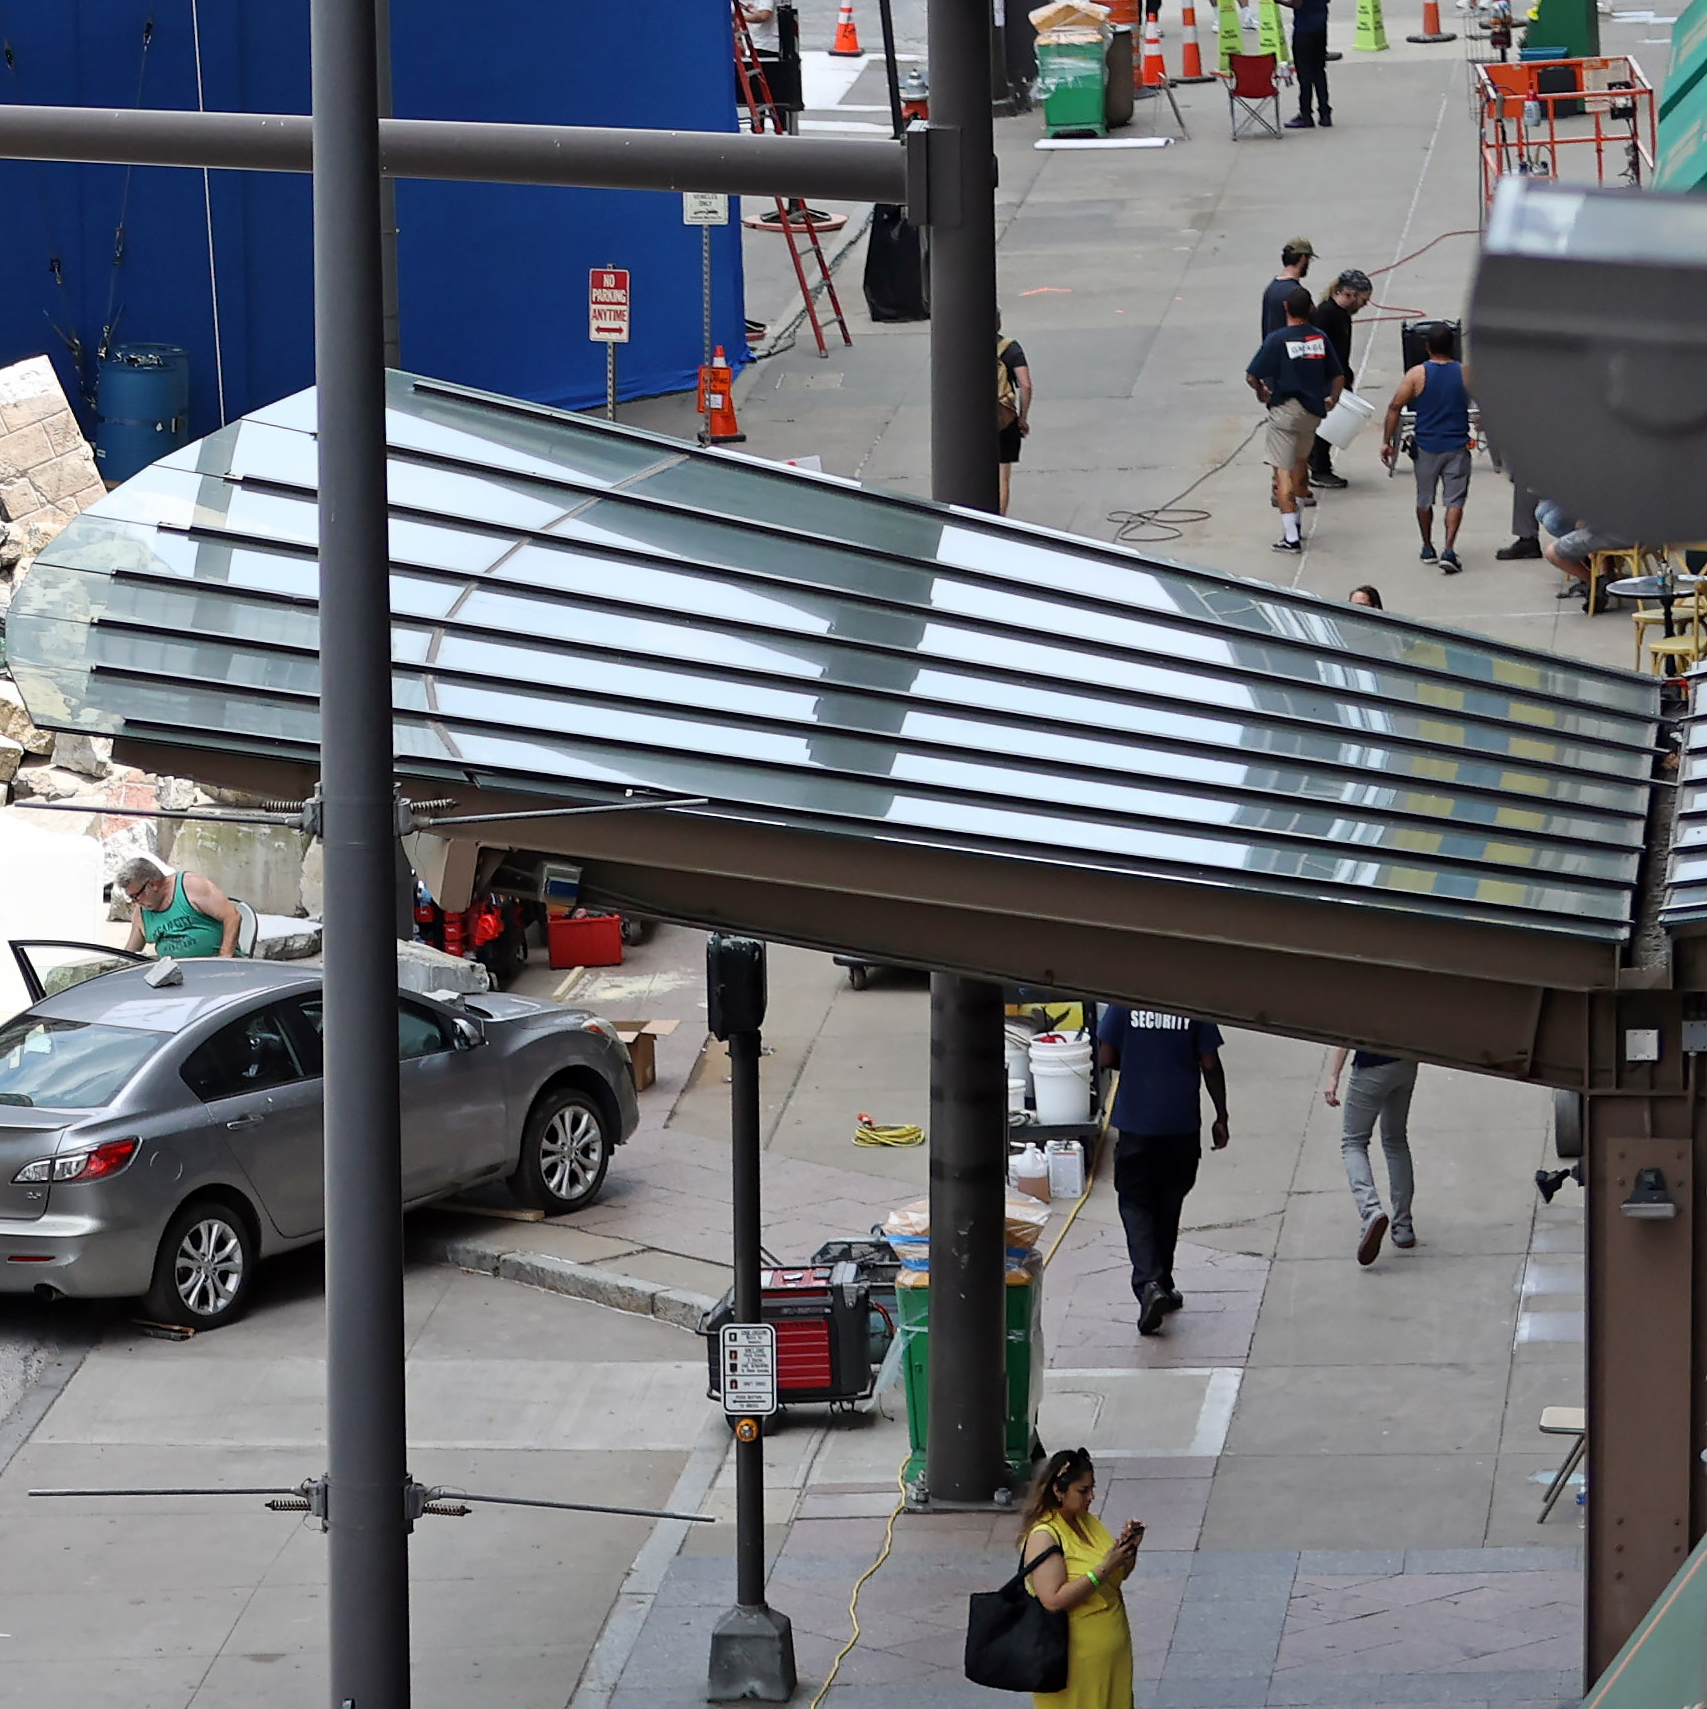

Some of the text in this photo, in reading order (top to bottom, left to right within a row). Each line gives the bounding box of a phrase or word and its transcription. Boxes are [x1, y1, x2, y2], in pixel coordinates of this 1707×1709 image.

[602, 274, 616, 288] NO
[592, 288, 627, 303] PARKING
[591, 308, 628, 322] ANYTIME
[1130, 1009, 1191, 1030] SECURITY
